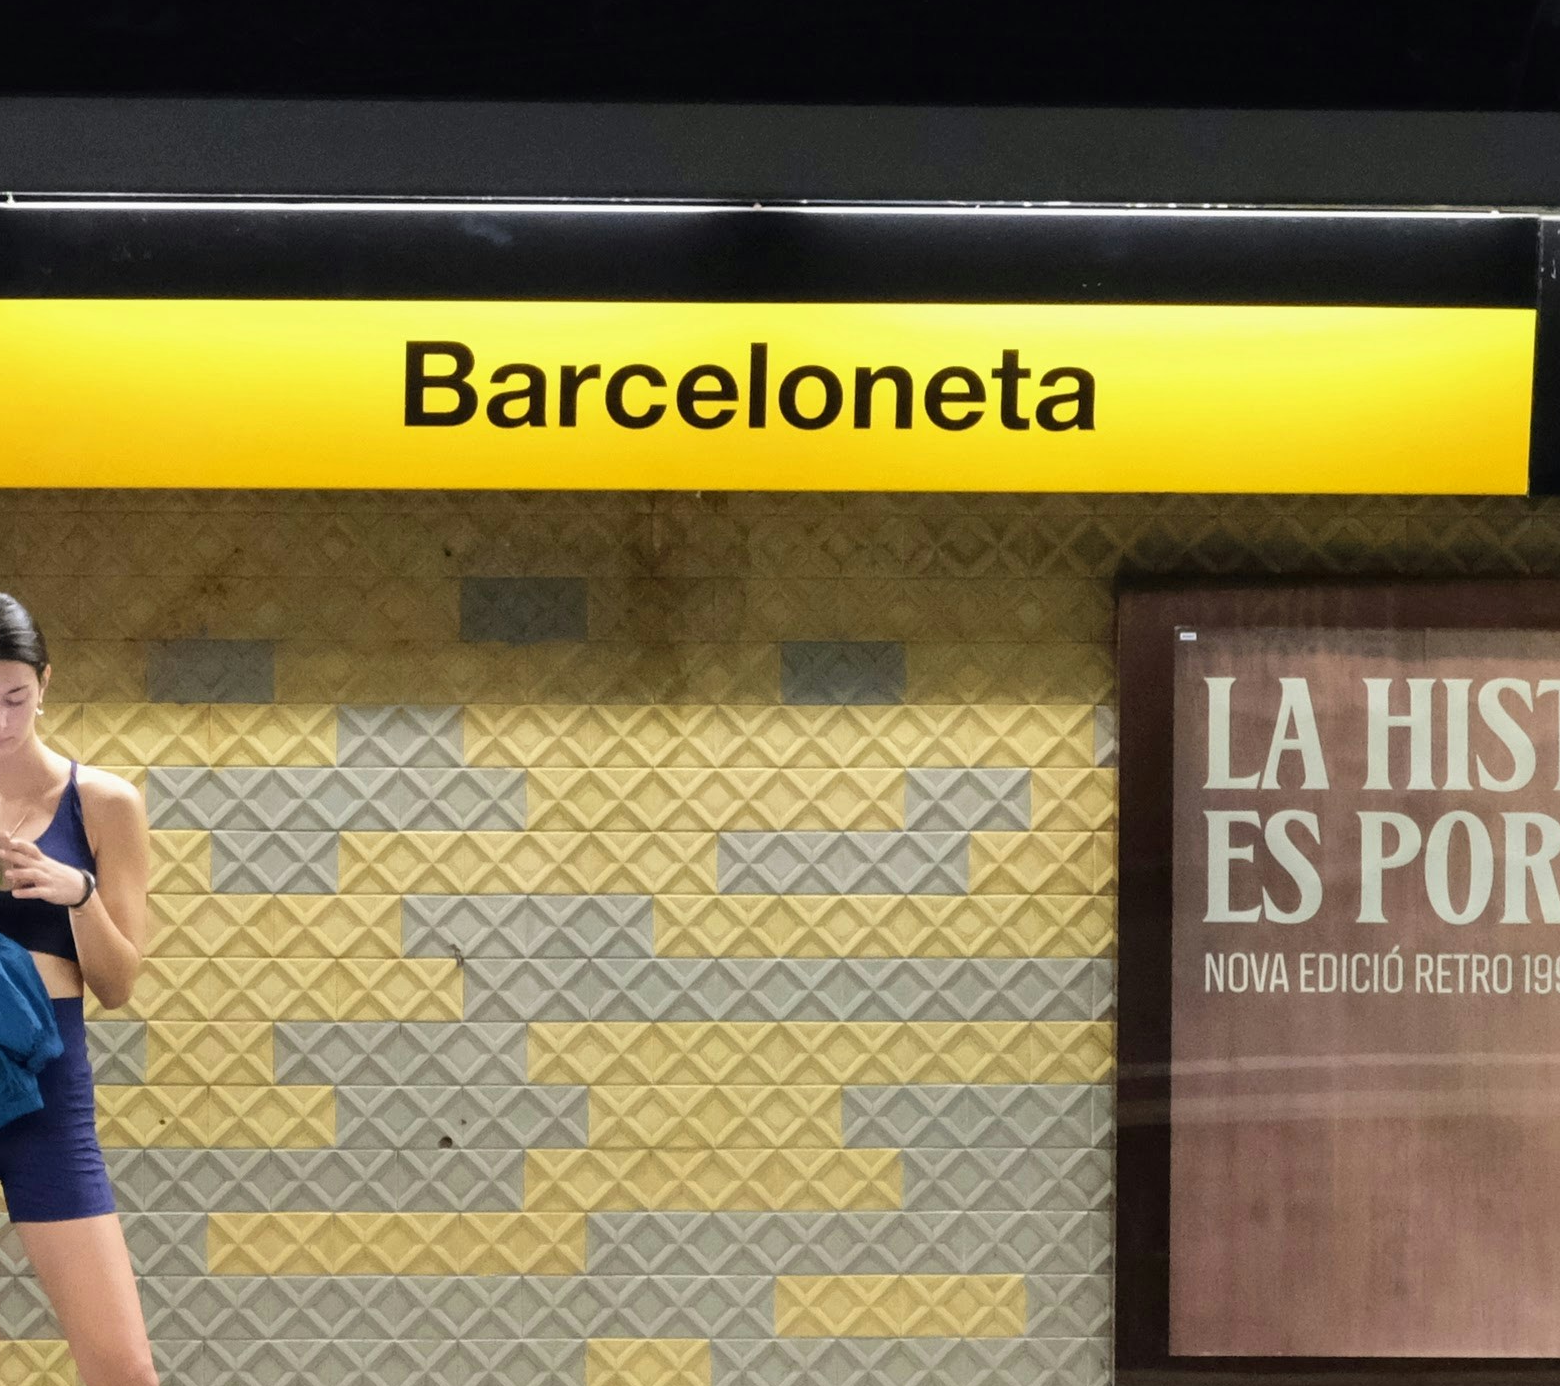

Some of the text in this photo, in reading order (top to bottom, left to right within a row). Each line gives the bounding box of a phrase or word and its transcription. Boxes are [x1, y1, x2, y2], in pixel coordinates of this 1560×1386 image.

[402, 340, 1097, 431] Barceloneta
[1202, 677, 1330, 791] LA
[1201, 809, 1324, 925] ES
[1204, 954, 1290, 994] NOVA
[1300, 945, 1404, 994] EDICIÓ
[1415, 954, 1513, 995] RETRO
